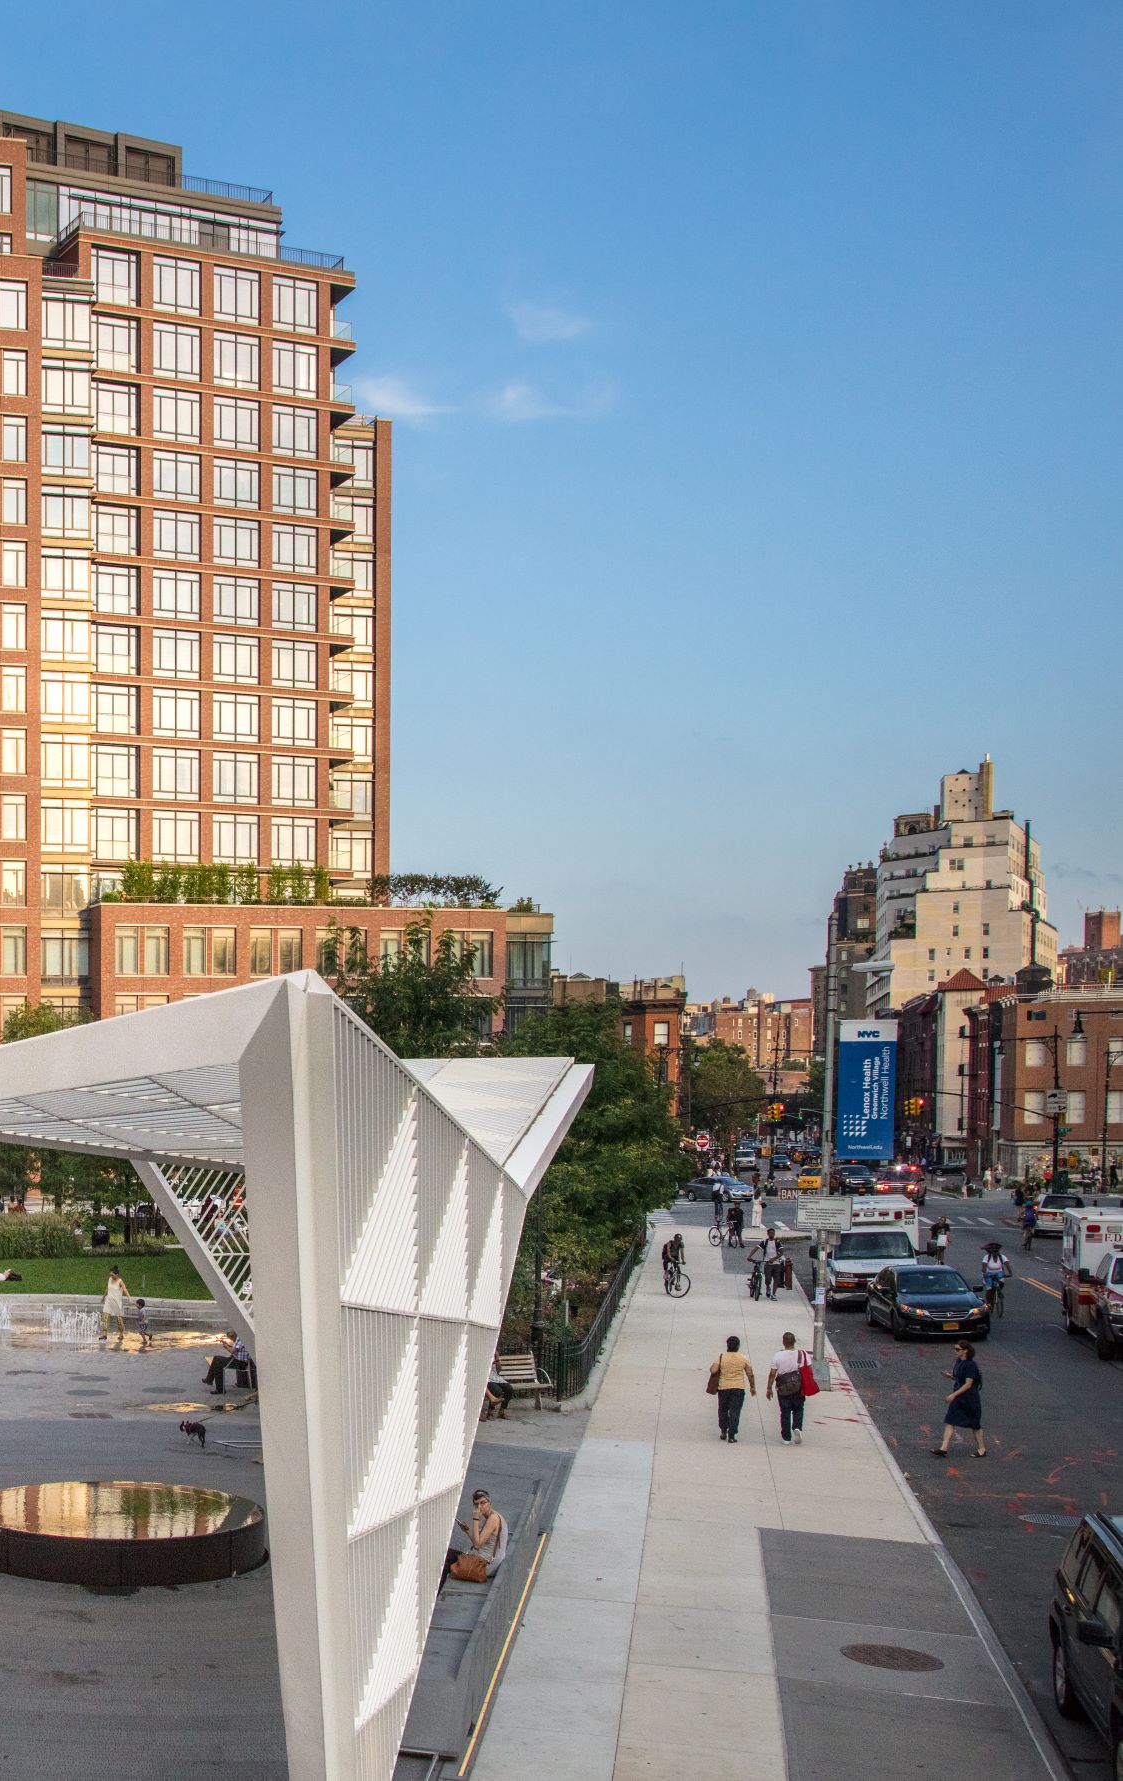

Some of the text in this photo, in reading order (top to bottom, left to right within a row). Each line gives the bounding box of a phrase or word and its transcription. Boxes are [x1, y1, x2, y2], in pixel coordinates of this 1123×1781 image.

[862, 1059, 871, 1119] Lenox Health
[880, 1046, 890, 1119] Northwell Health
